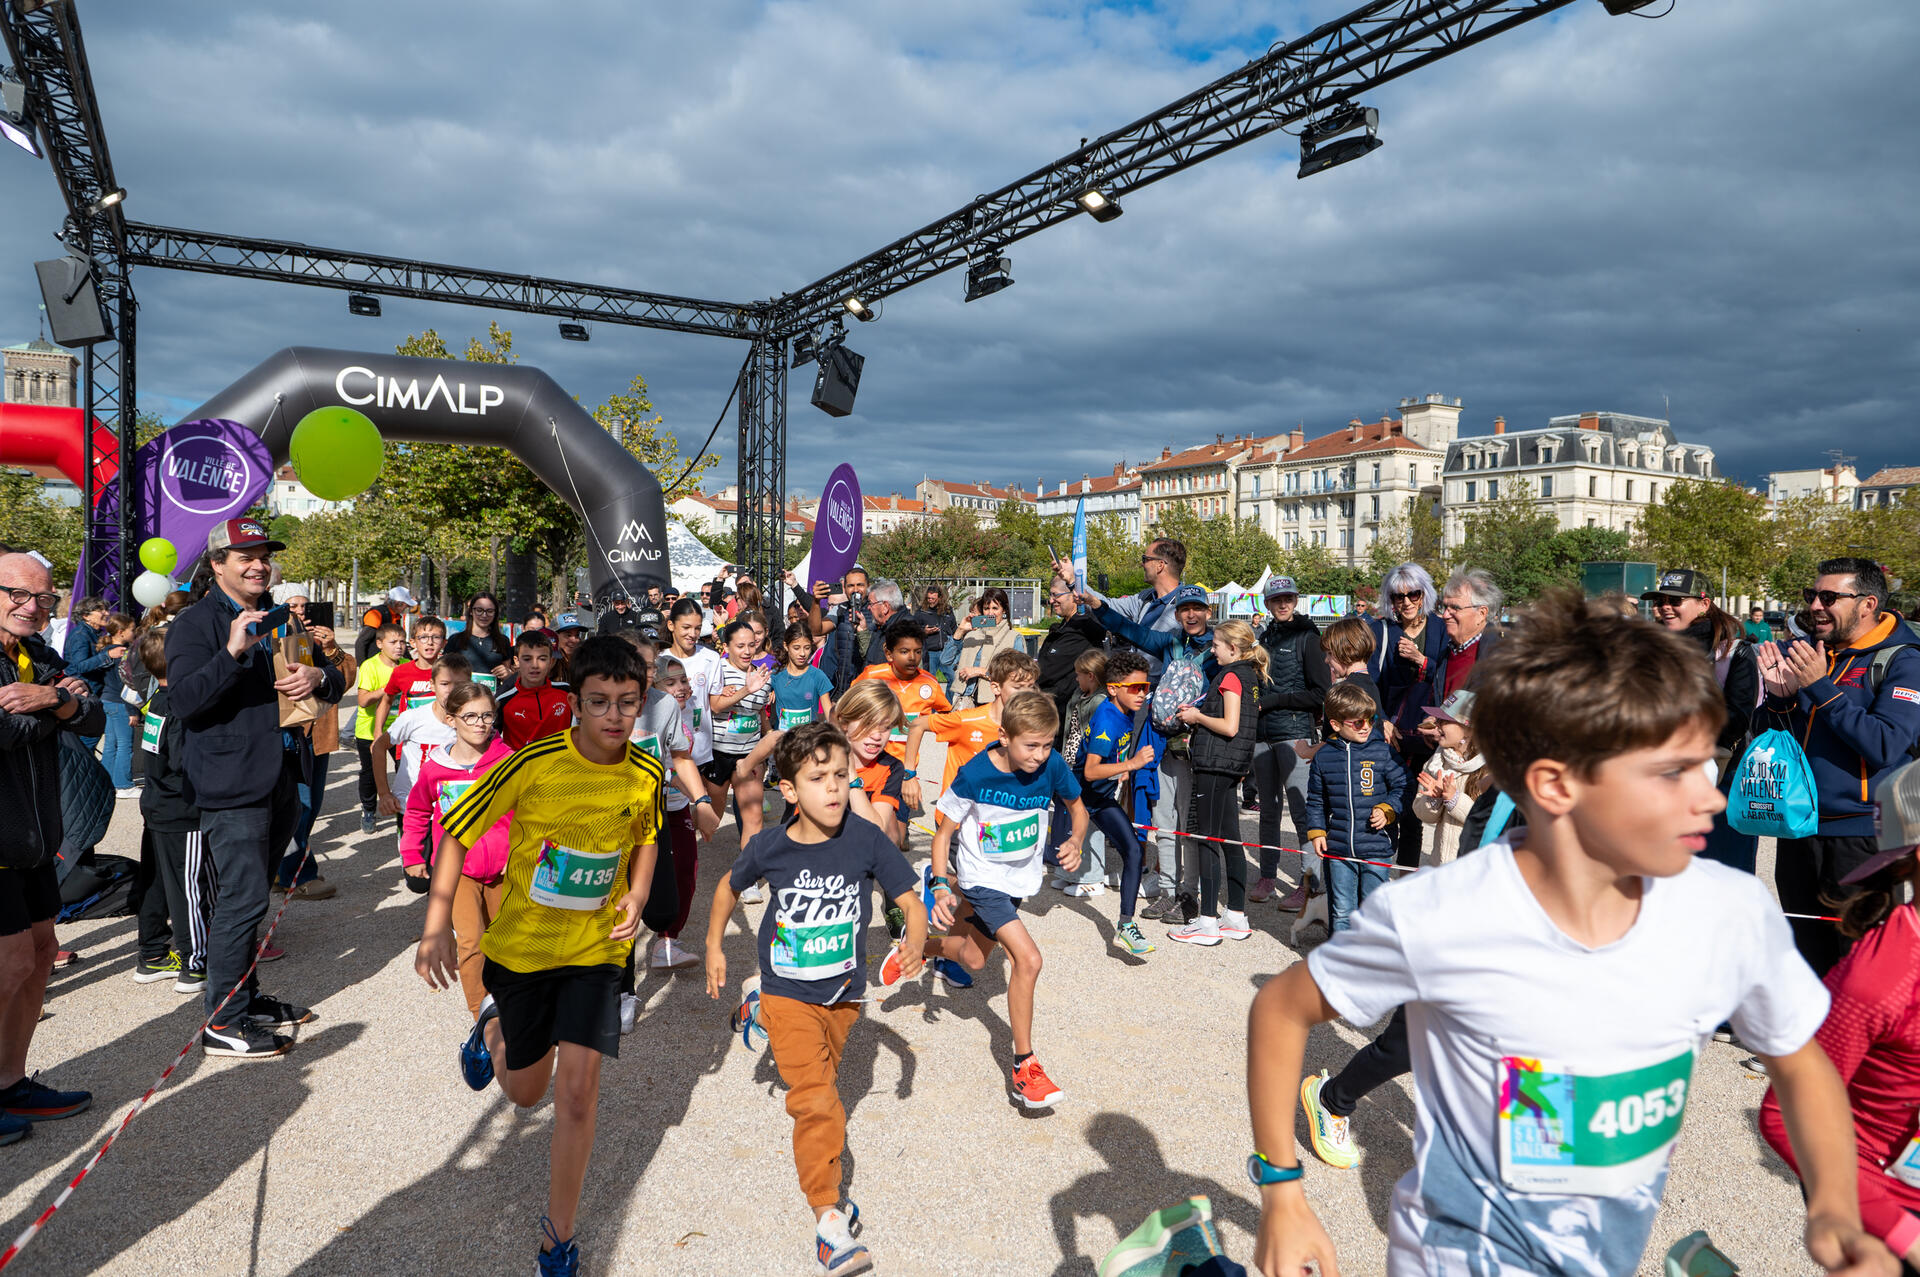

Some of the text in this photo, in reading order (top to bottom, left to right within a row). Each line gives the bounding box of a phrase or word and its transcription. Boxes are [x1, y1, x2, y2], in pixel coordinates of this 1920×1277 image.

[335, 366, 505, 416] CIMALP
[168, 455, 244, 493] VALENCE
[830, 498, 854, 537] VALENCE
[608, 547, 662, 564] CIMALP
[790, 715, 810, 724] 4128
[1360, 767, 1374, 789] 9
[1748, 761, 1756, 778] &
[1758, 762, 1767, 779] 10
[1769, 763, 1787, 780] KM
[980, 788, 993, 802] LE
[993, 791, 1017, 807] COQ
[1741, 779, 1785, 800] VALENCE
[1005, 823, 1037, 843] 4140
[569, 867, 615, 886] 4135
[793, 869, 860, 899] Sur Les
[775, 887, 861, 926] Flots
[802, 933, 850, 955] 4047
[1588, 1078, 1687, 1139] 4053
